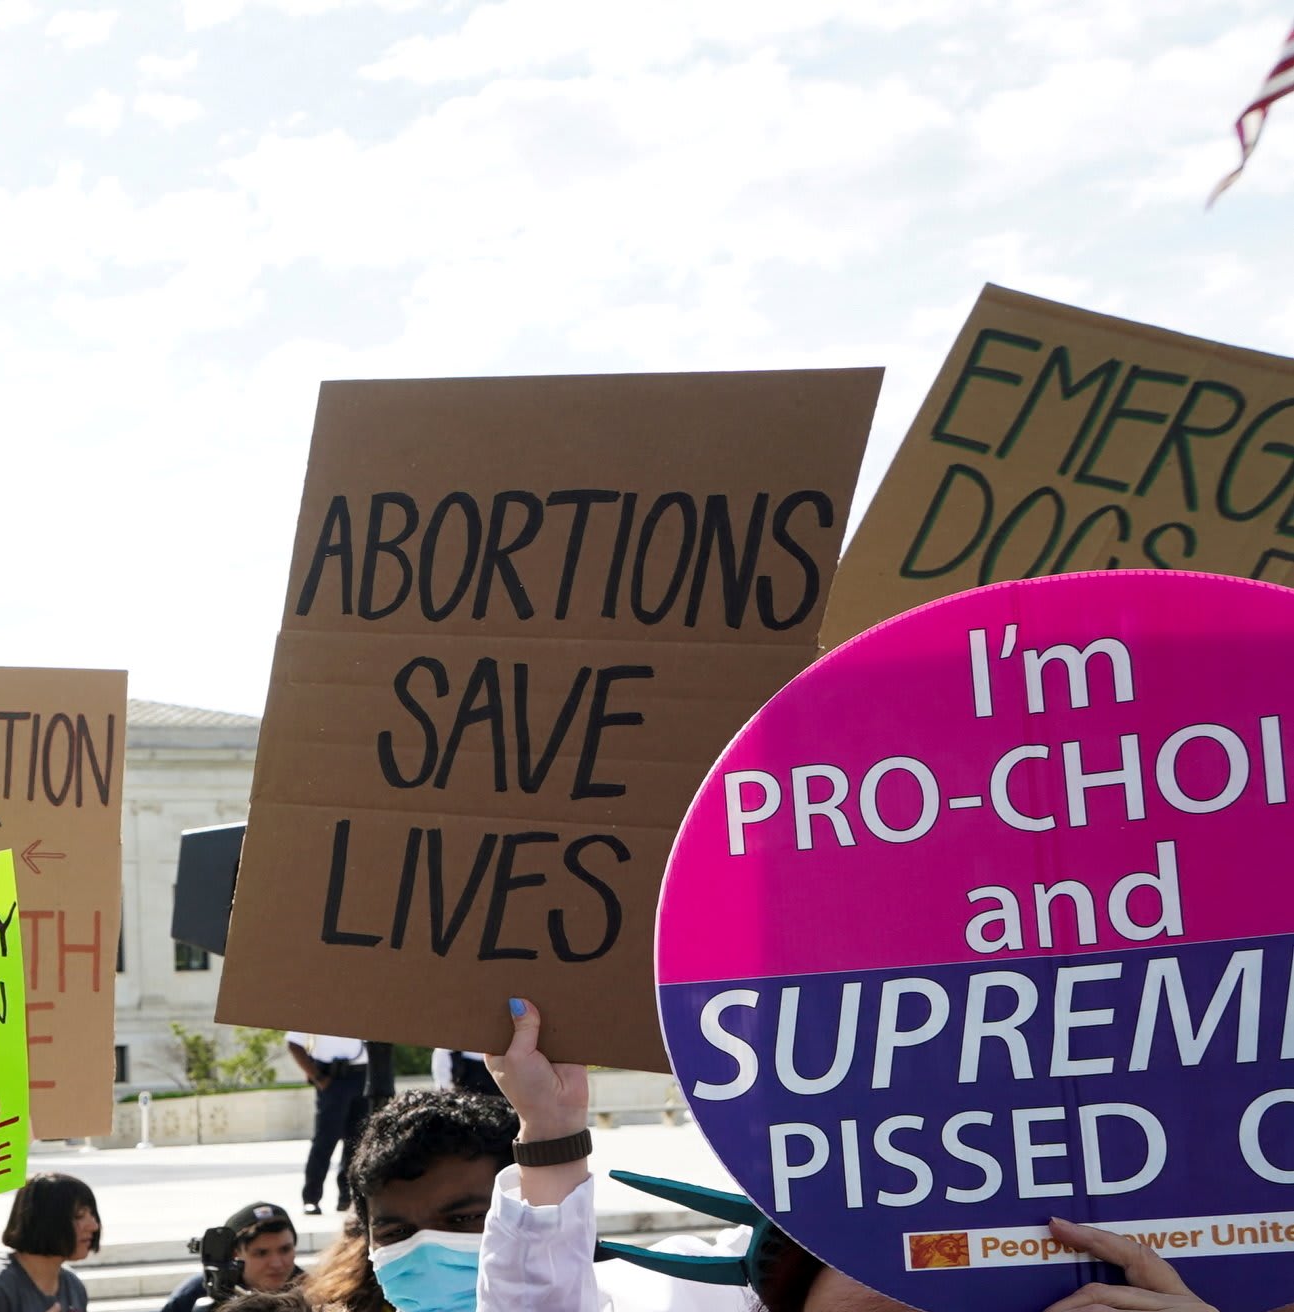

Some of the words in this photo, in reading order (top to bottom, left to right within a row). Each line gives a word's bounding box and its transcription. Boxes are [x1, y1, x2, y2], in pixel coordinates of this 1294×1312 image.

[930, 328, 1294, 536] EMERG
[296, 488, 835, 631] ABORTIONS
[377, 656, 654, 800] SAVE
[723, 715, 1287, 856] PRO-CHOI
[321, 818, 631, 963] LIVES
[965, 840, 1184, 954] and
[692, 948, 1294, 1102] SUPREM
[768, 1102, 1168, 1213] PISSED
[981, 1235, 1090, 1261] Peop
